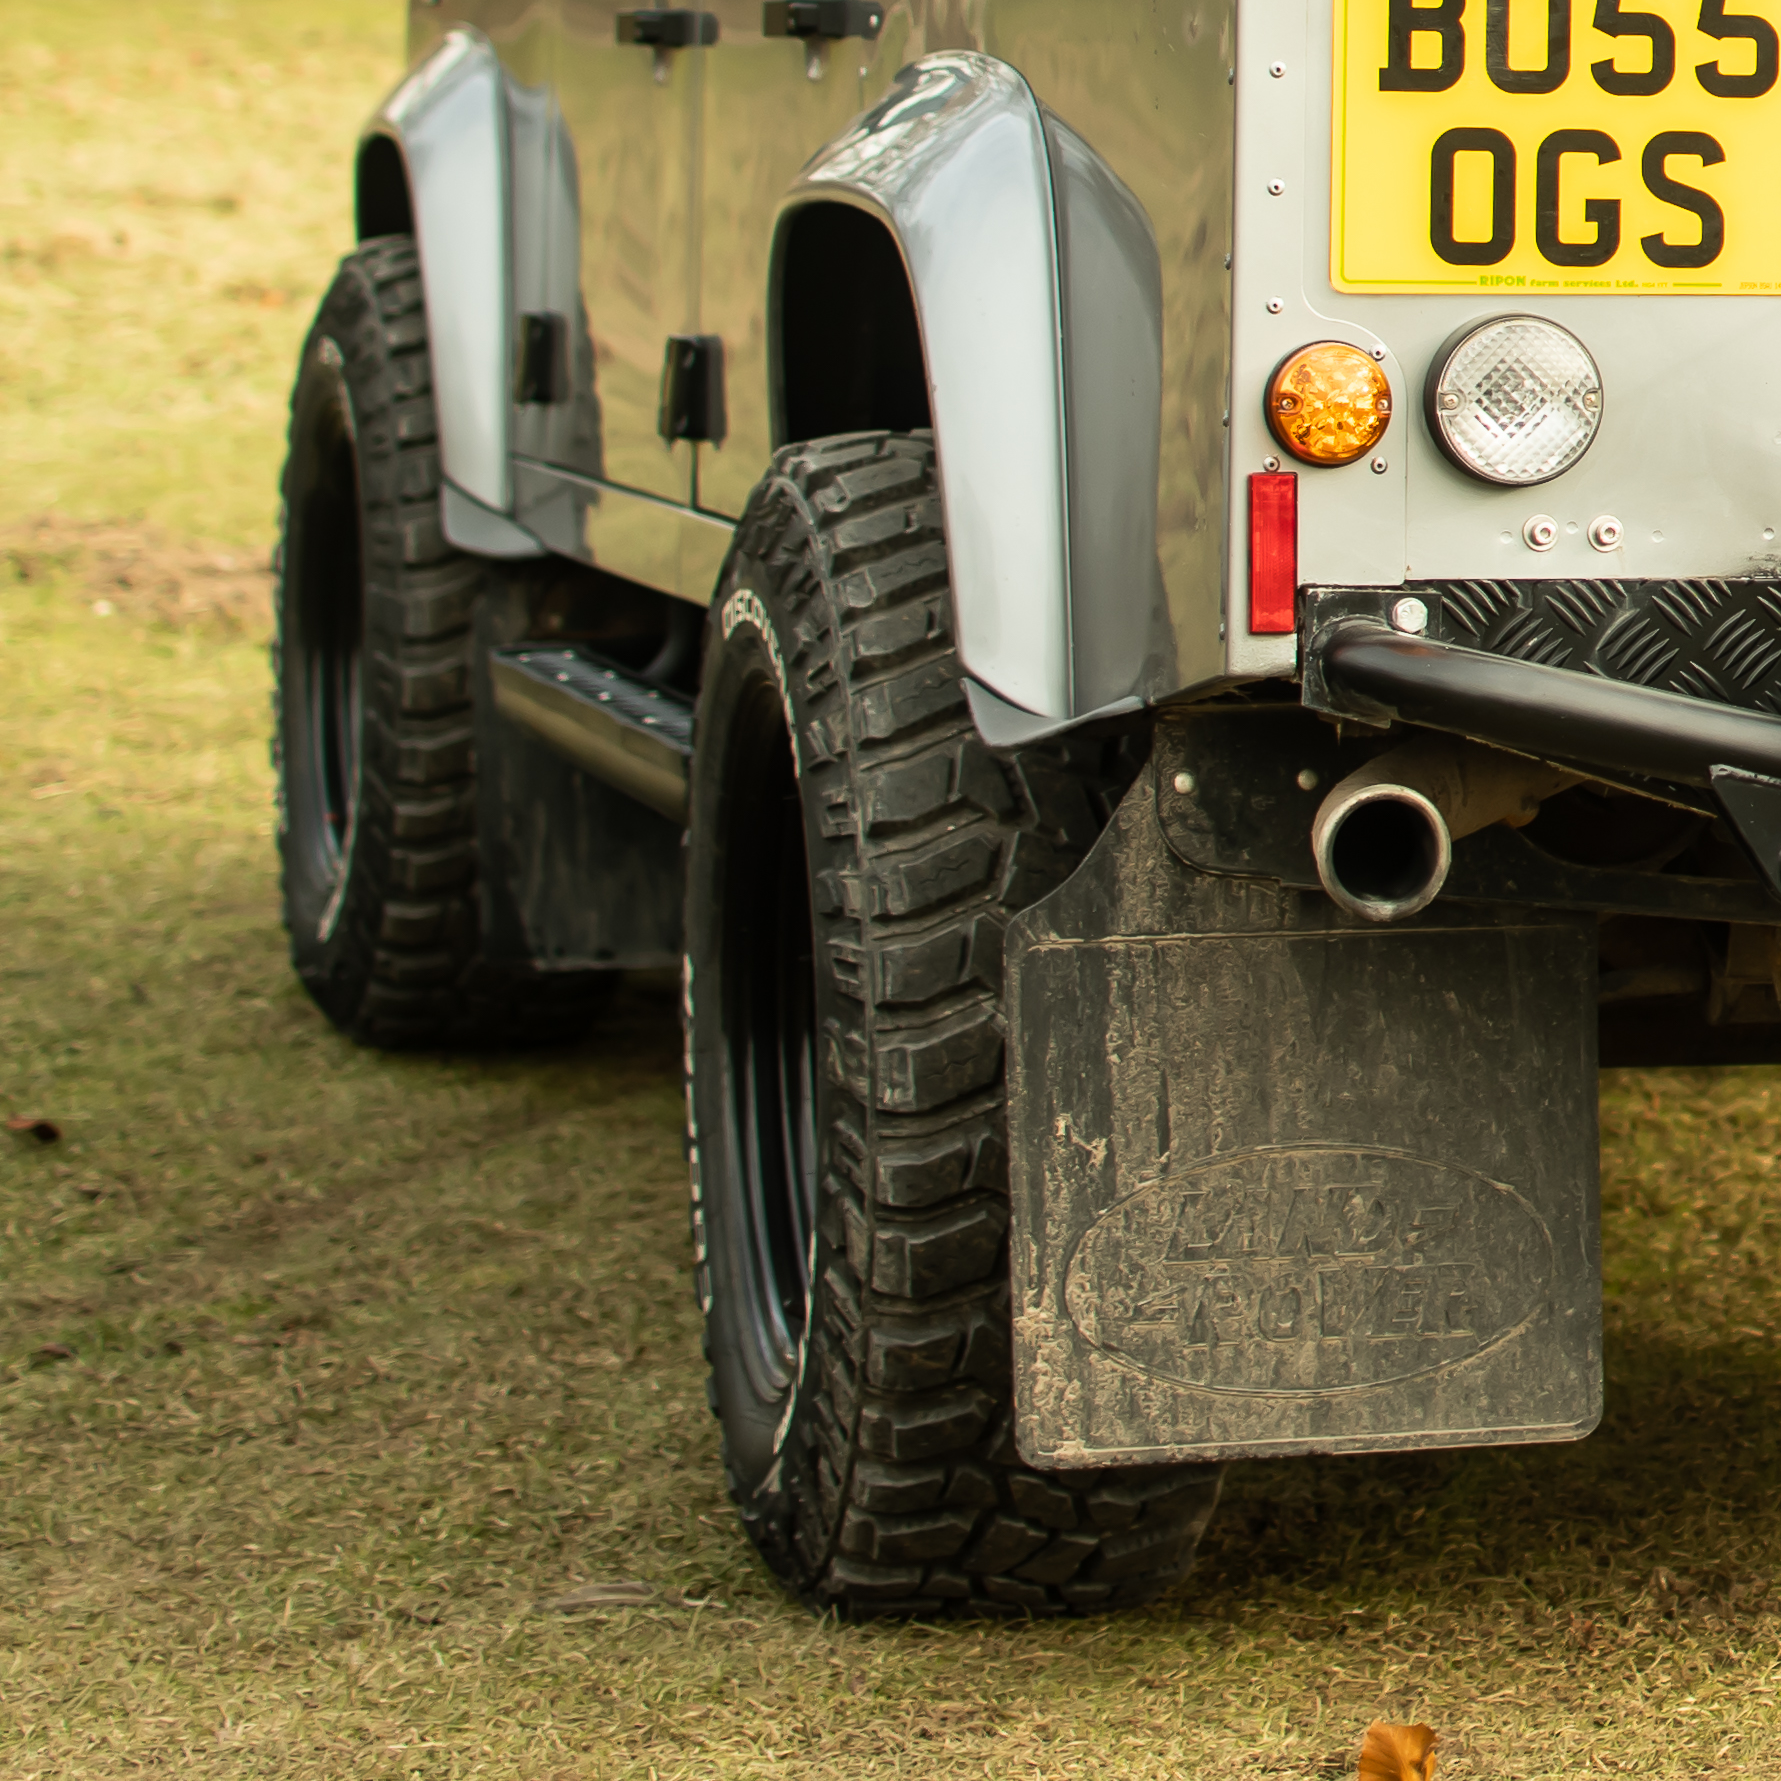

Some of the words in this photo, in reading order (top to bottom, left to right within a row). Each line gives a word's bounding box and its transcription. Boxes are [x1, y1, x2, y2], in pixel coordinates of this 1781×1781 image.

[1429, 126, 1727, 269] OGS
[1479, 275, 1527, 287] RIPON
[1530, 278, 1559, 288] farm
[1563, 279, 1612, 288] services
